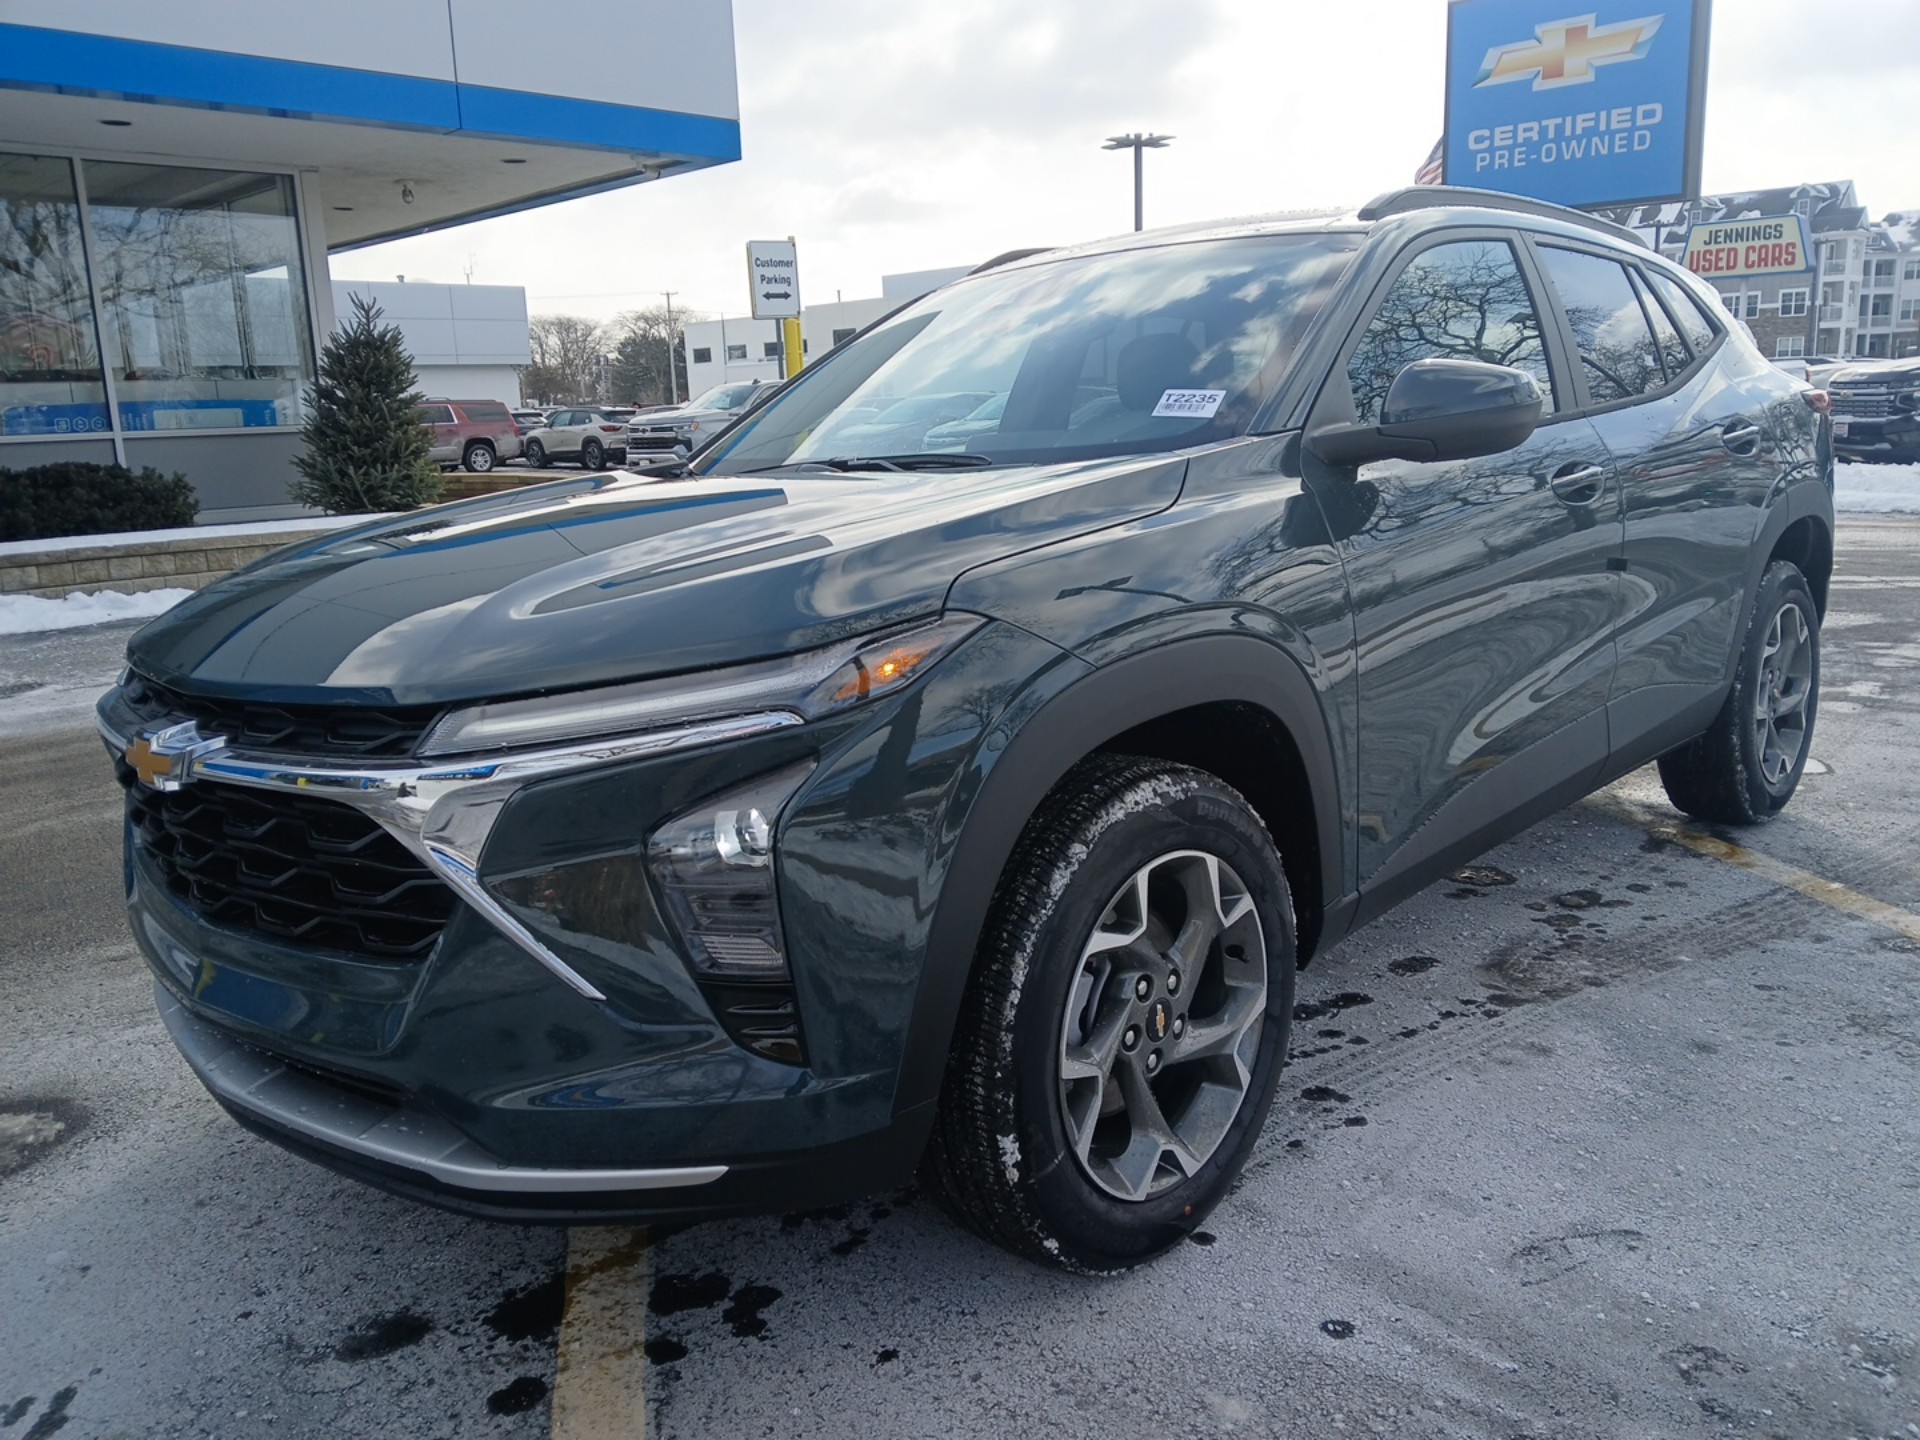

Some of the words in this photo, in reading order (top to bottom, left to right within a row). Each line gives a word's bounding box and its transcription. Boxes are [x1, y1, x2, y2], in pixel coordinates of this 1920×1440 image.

[1468, 102, 1663, 151] CERTIFIED
[1475, 129, 1651, 173] PRE-OWNED
[1703, 223, 1784, 246] JENNINGS
[754, 257, 794, 268] Customer
[1688, 247, 1739, 274] USED
[1744, 242, 1797, 269] CARS
[760, 274, 792, 287] Parking
[1164, 393, 1220, 404] T2235
